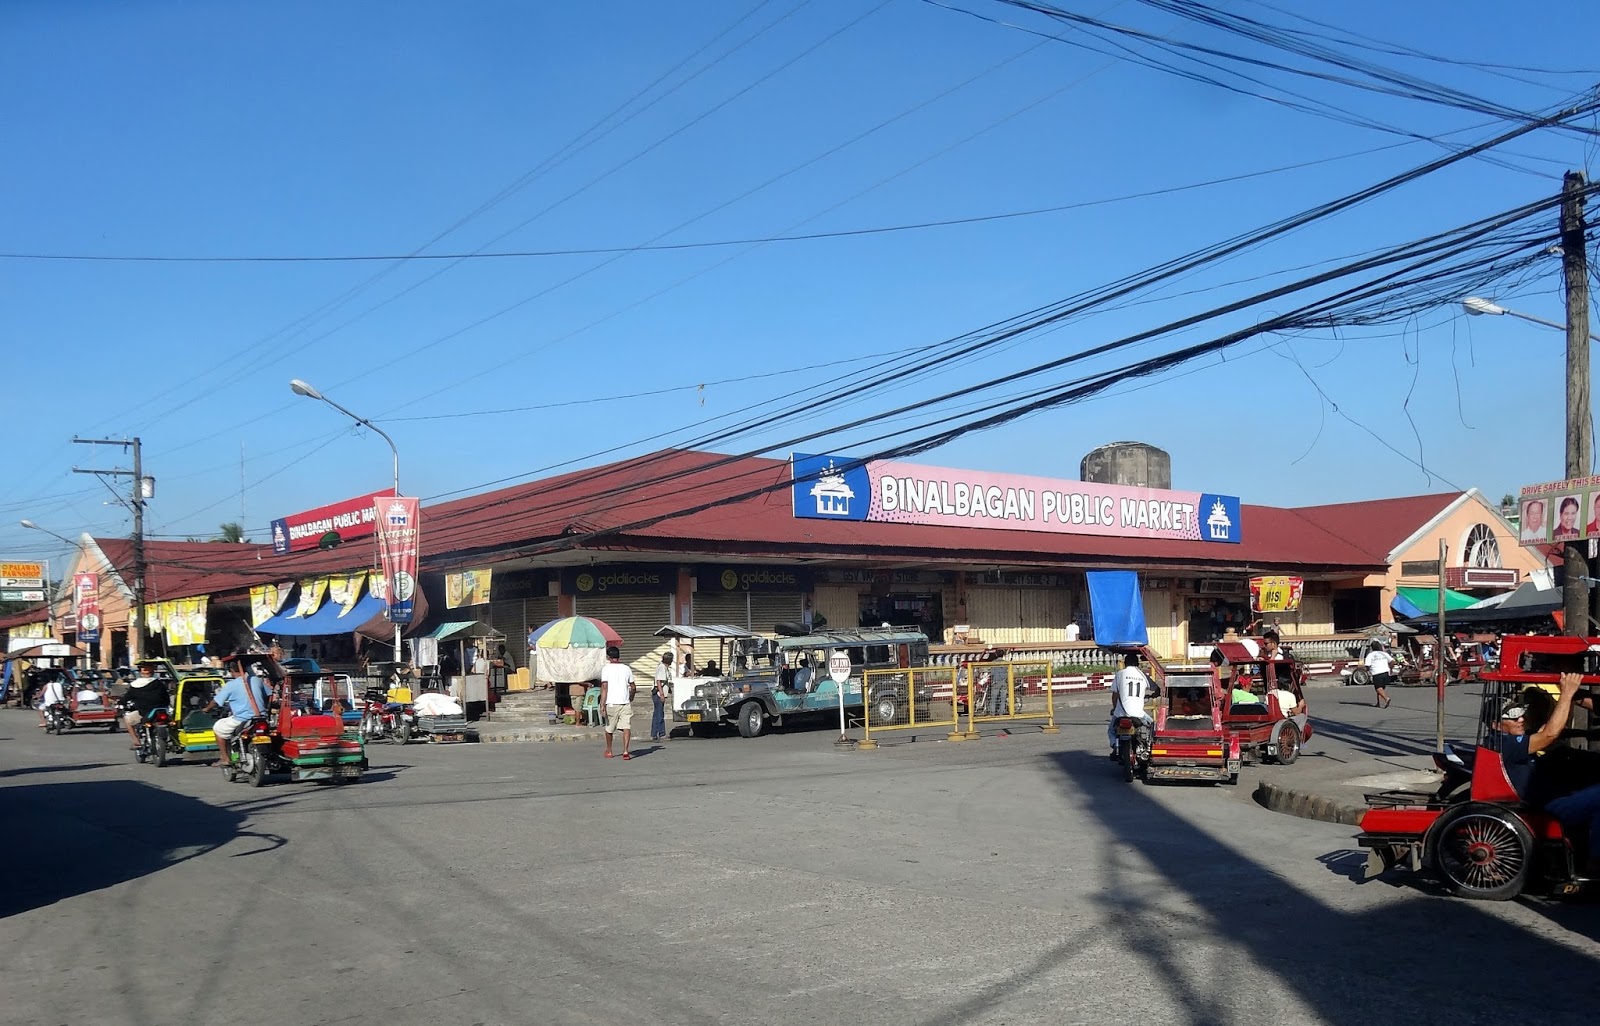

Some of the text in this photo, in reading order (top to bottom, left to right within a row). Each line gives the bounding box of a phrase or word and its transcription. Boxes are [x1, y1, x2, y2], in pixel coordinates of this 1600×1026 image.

[1521, 485, 1541, 495] DRIVE
[1543, 481, 1570, 492] SAFELY
[1572, 478, 1589, 488] THIS
[820, 494, 848, 512] TM
[880, 475, 1194, 531] BINALBAGAN PUBLIC MARKET
[289, 518, 333, 541] BINALBAGAN
[333, 511, 360, 530] PUBLIC
[390, 516, 406, 525] TM
[379, 528, 417, 540] EXTEND
[1212, 525, 1228, 536] TM
[598, 572, 660, 592] goldilocks
[741, 570, 796, 590] goldilocks
[1127, 681, 1141, 698] 11
